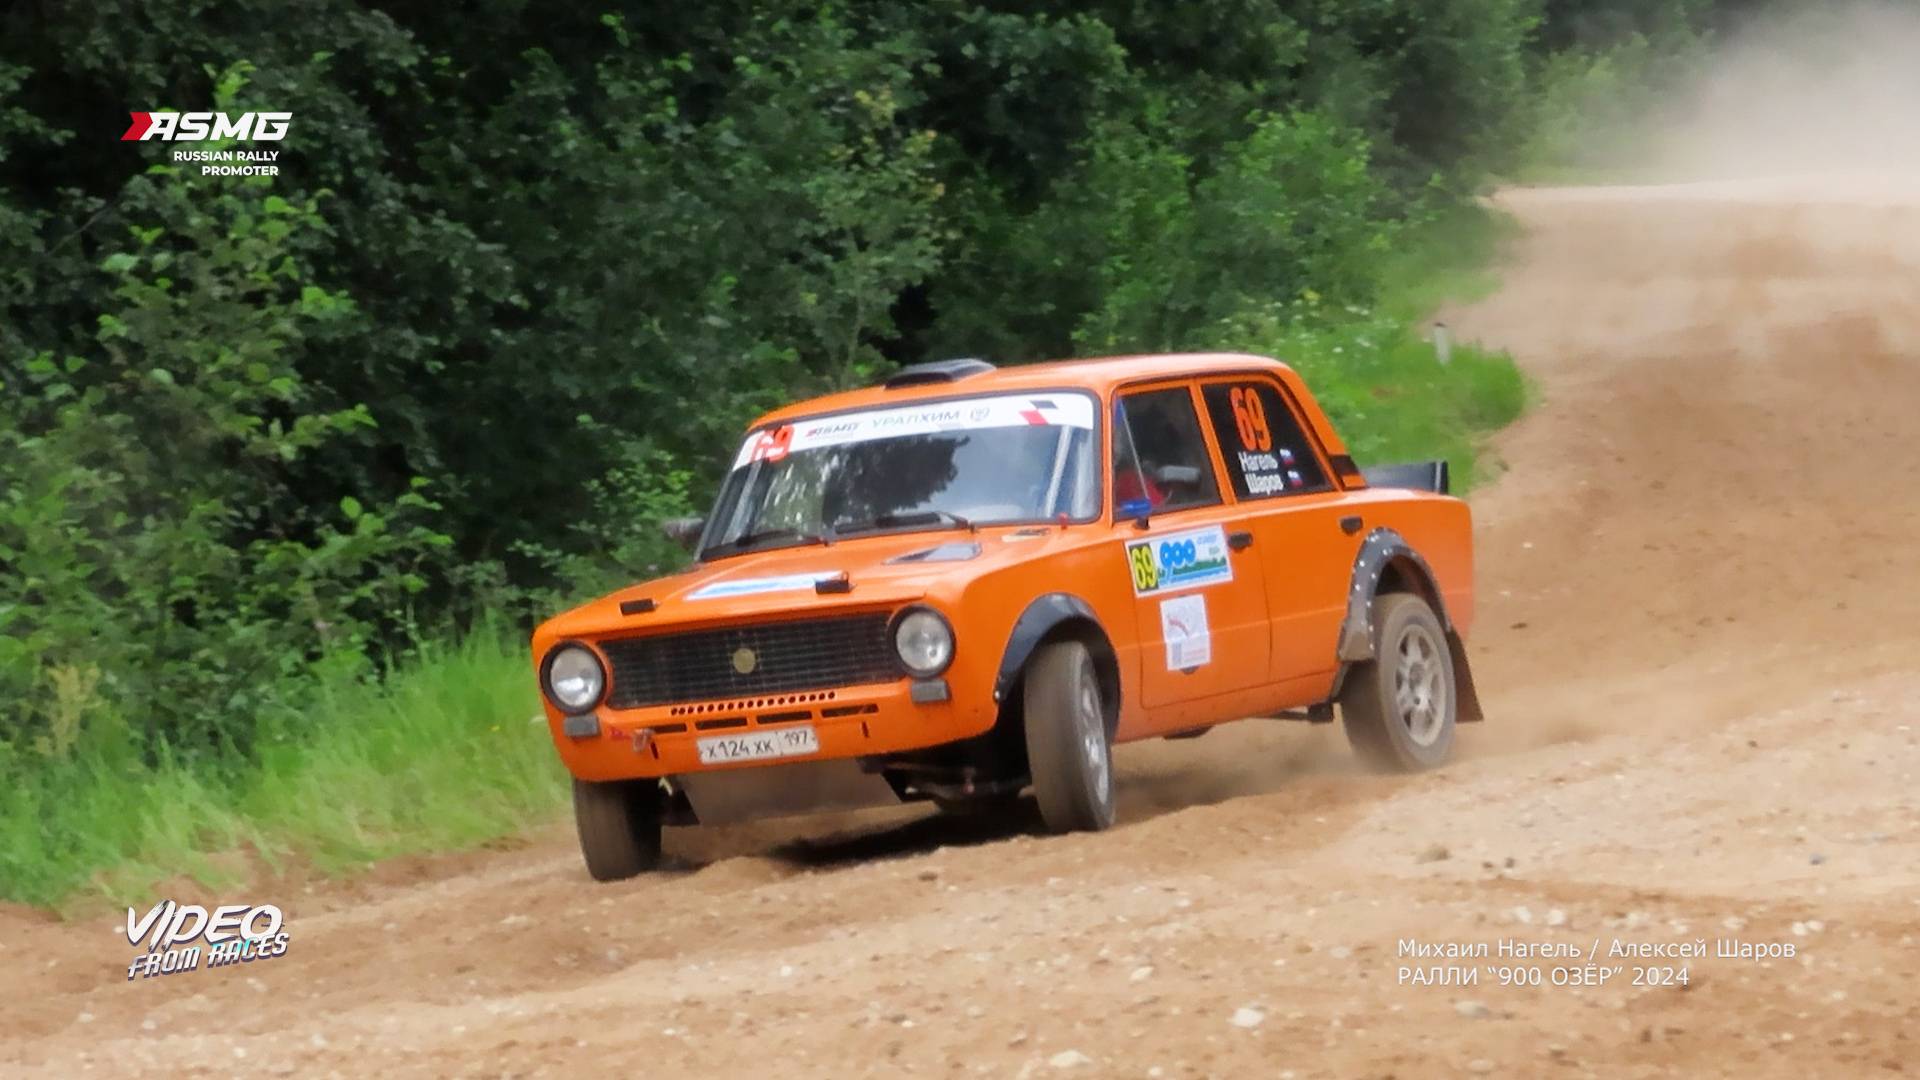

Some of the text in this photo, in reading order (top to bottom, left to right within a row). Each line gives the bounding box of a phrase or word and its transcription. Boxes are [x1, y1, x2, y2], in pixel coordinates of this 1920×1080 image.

[1230, 387, 1272, 452] 69
[1131, 546, 1157, 590] 69
[784, 730, 808, 746] 197
